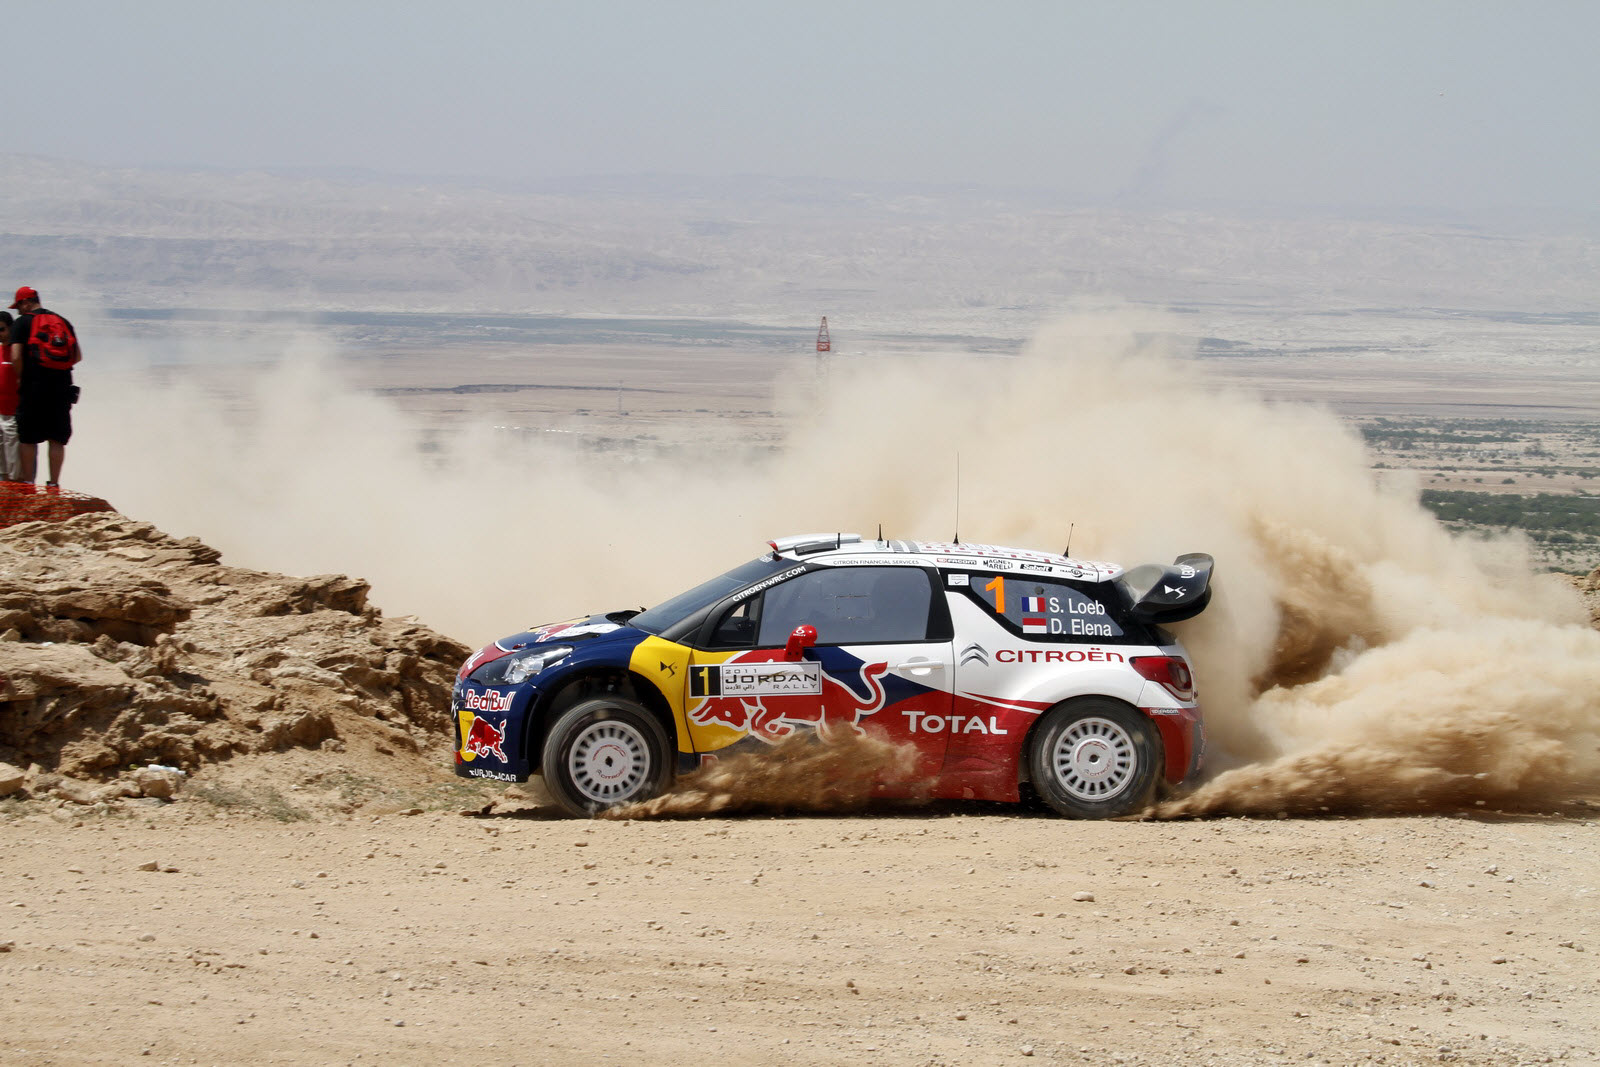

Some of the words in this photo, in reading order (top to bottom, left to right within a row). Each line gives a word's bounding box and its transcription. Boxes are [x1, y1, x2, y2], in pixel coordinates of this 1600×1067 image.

[985, 576, 1005, 613] 1
[1049, 597, 1064, 613] S.
[1069, 598, 1105, 615] Loeb
[1050, 618, 1067, 635] D.
[1071, 619, 1112, 636] Elena
[699, 666, 709, 696] 1
[725, 674, 817, 683] JORDAN
[465, 688, 491, 711] Red
[489, 690, 516, 712] Bull
[901, 711, 1008, 734] TOTAL
